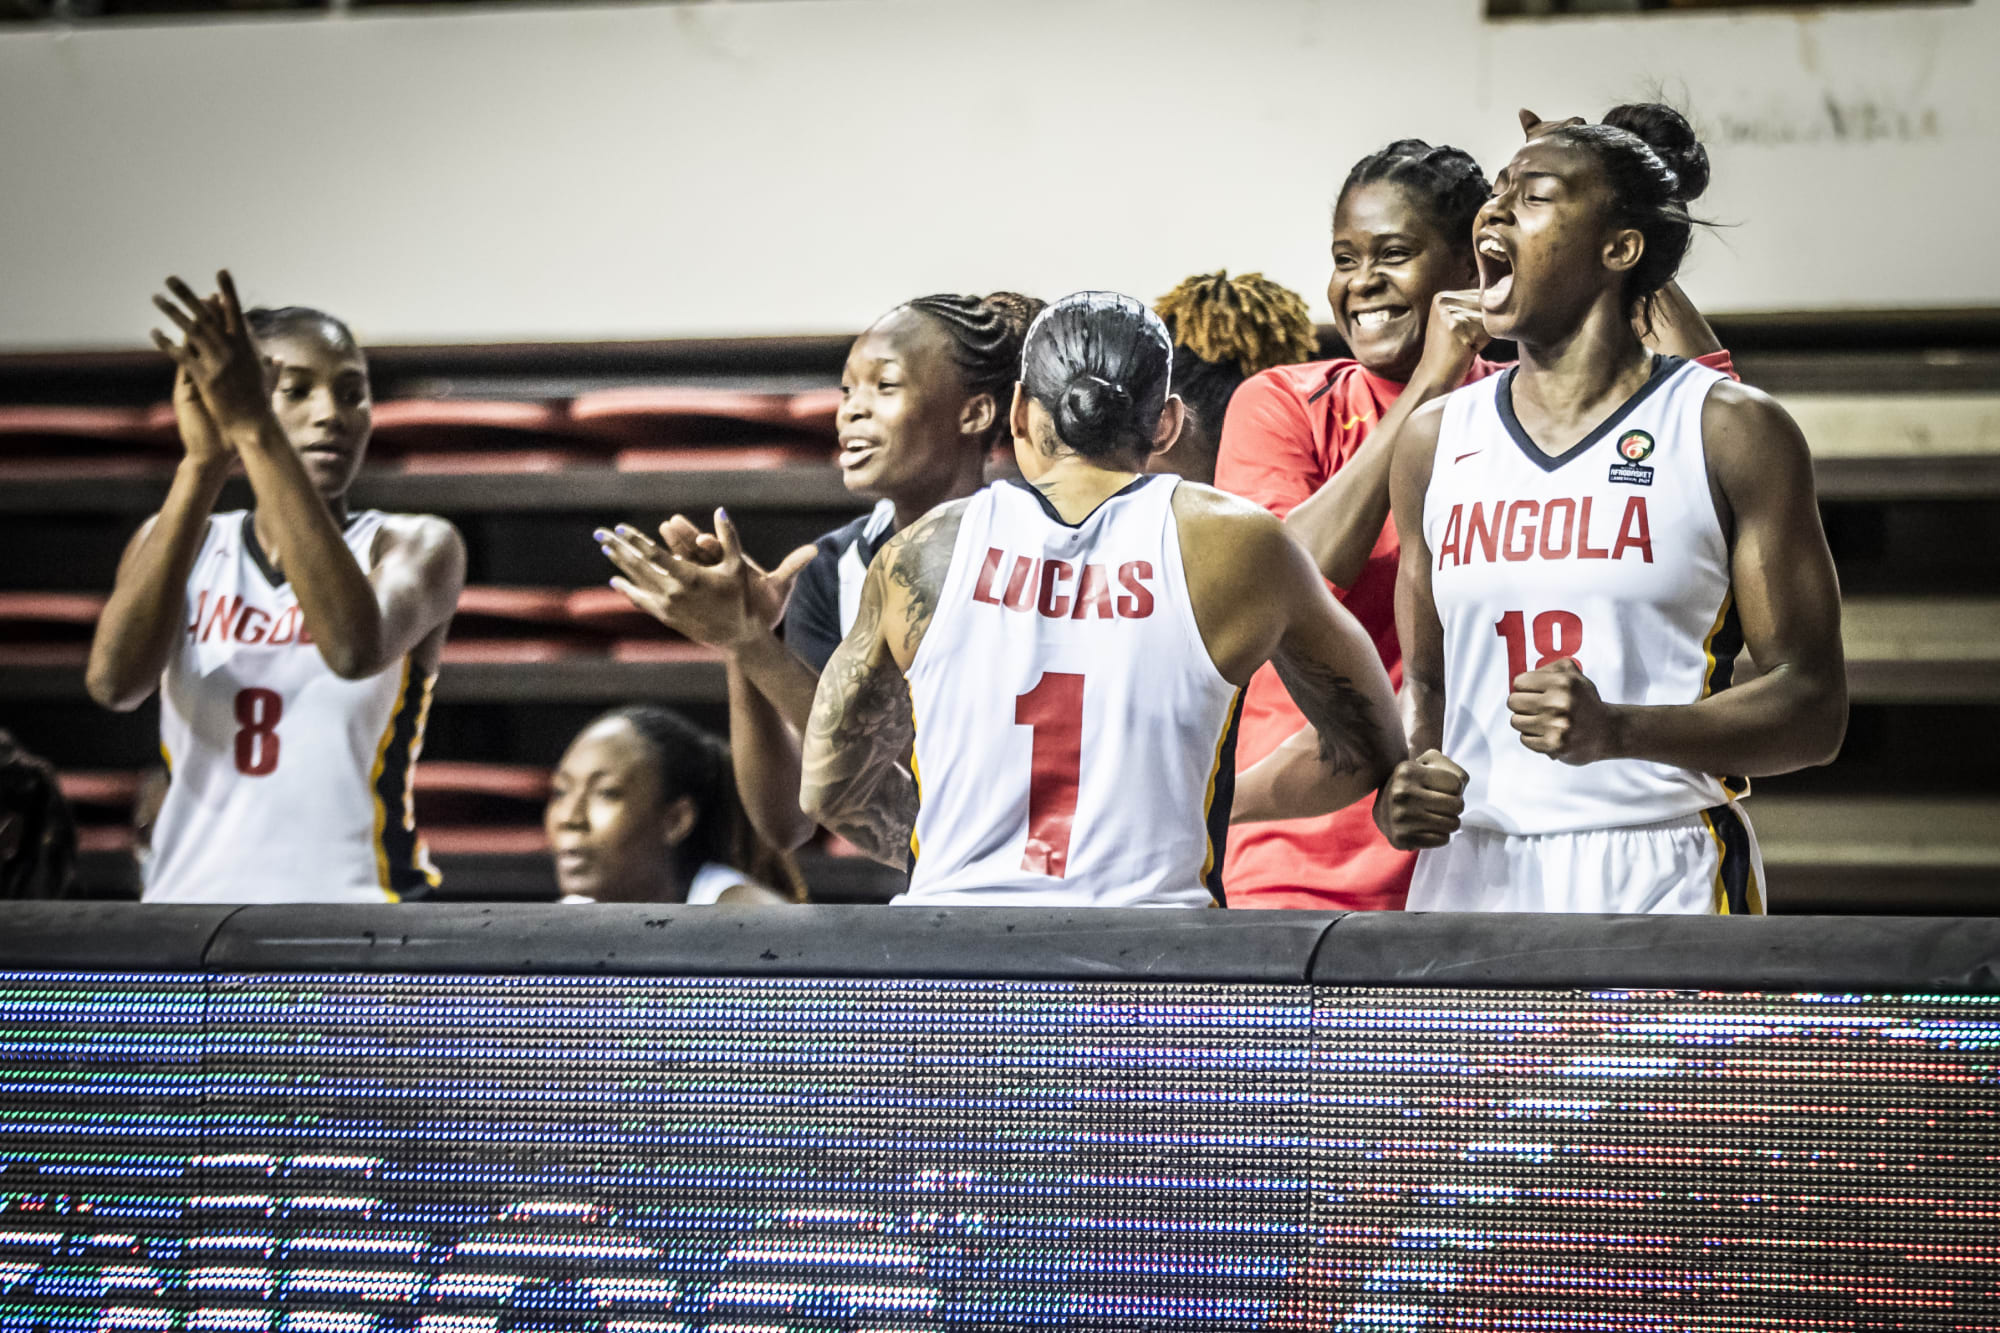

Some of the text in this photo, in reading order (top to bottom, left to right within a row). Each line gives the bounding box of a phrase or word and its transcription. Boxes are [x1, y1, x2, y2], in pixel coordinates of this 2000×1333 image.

[1438, 495, 1654, 571] ANGOLA
[972, 546, 1155, 619] LUCAS
[1494, 609, 1584, 695] 18
[233, 687, 284, 777] 8
[1014, 671, 1086, 880] 1
